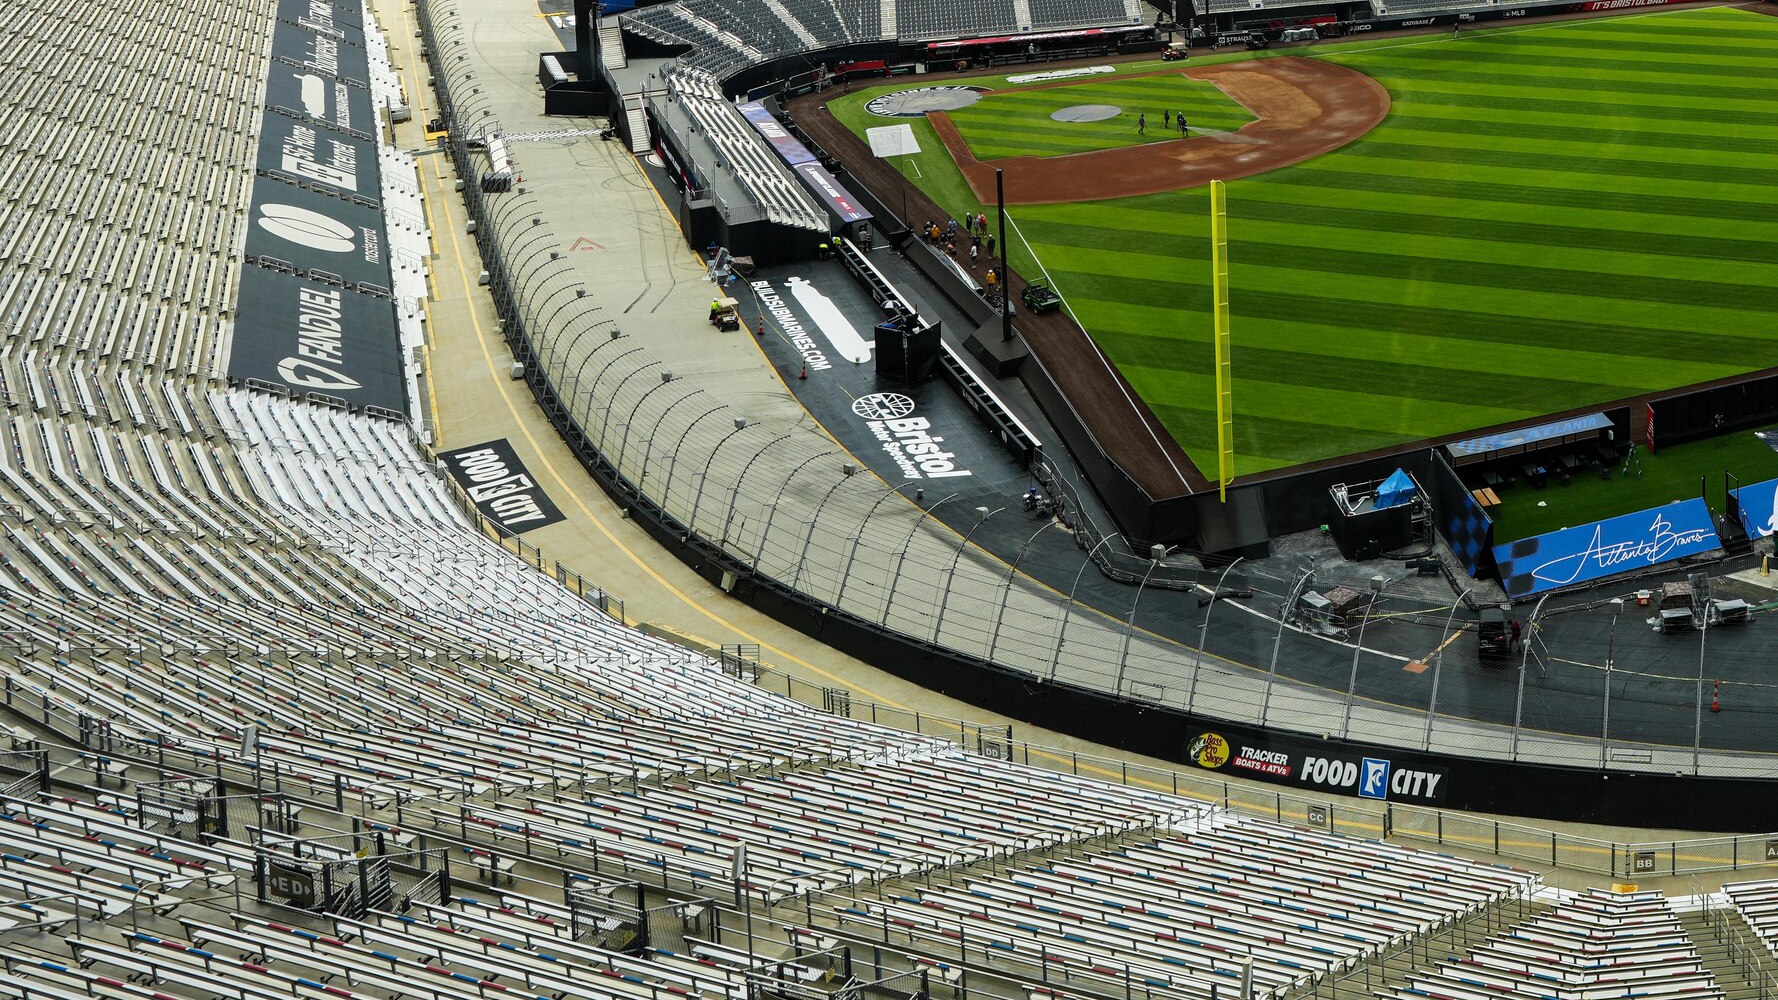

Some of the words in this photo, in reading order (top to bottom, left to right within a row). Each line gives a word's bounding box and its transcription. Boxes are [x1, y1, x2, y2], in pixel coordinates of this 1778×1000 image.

[1592, 1, 1610, 10] IT'S
[1226, 35, 1252, 43] STRAUSS
[304, 35, 338, 76] Budweiser
[284, 125, 316, 150] Home
[325, 138, 356, 175] Internet
[359, 226, 379, 265] mastercard
[298, 289, 342, 363] FANDUEL
[750, 280, 832, 371] BUILDSUBMARINES.COM
[1525, 416, 1598, 441] ATLANTA
[865, 420, 893, 443] Motor
[882, 440, 922, 479] Speedway
[884, 416, 973, 478] Bristol
[454, 448, 510, 482] FOOD
[490, 494, 546, 525] CITY
[1206, 734, 1222, 747] Bass
[1206, 743, 1217, 755] Pro
[1203, 751, 1223, 766] Shops
[1235, 757, 1261, 771] BOATS
[1267, 764, 1287, 775] ATVs
[1240, 746, 1289, 765] TRACKER
[1300, 756, 1358, 787] FOOD
[1391, 768, 1442, 798] CITY
[1309, 812, 1324, 823] CC
[1636, 859, 1653, 869] BB
